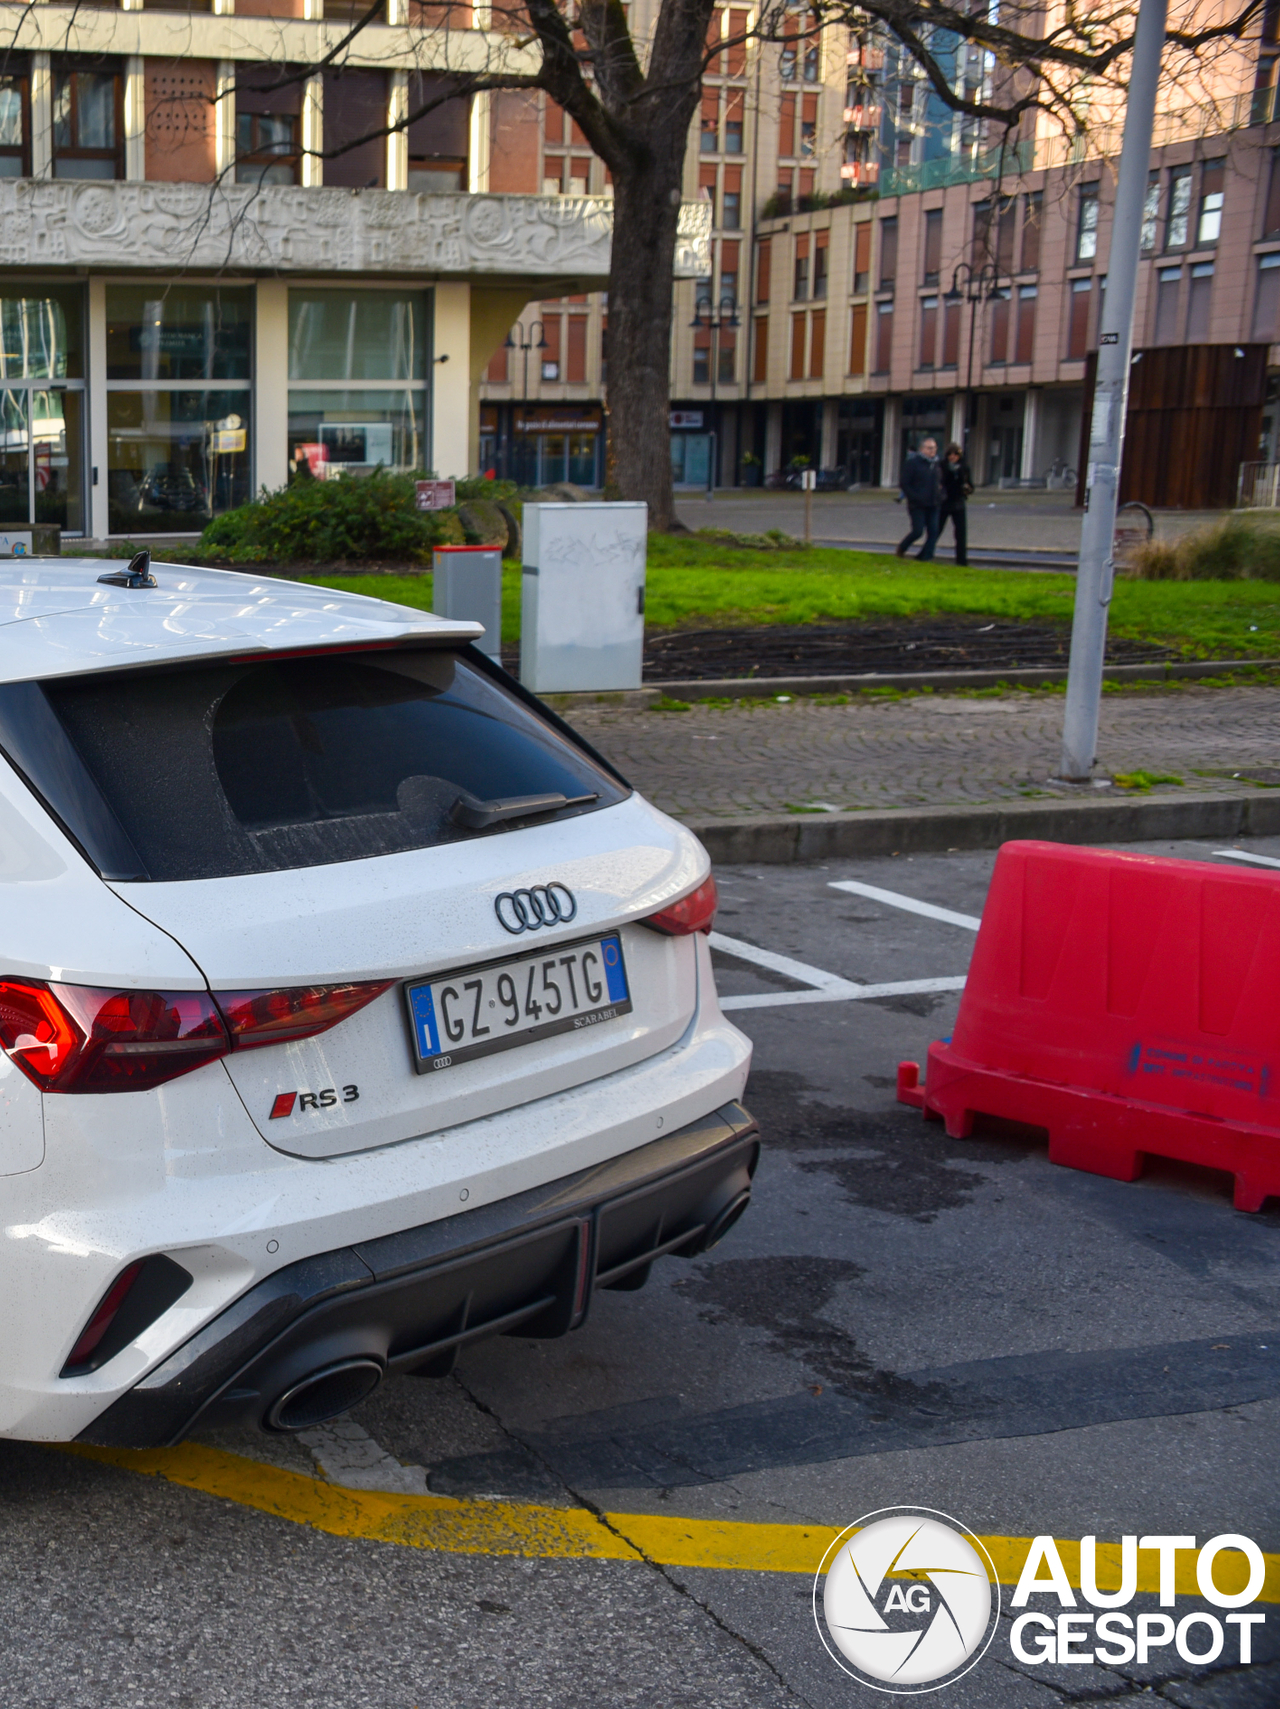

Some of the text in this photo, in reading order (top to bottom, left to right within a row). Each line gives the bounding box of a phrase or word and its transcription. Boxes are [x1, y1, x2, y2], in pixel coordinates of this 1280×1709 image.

[440, 951, 604, 1043] GZ 945TG
[573, 1007, 620, 1029] SCARABEL
